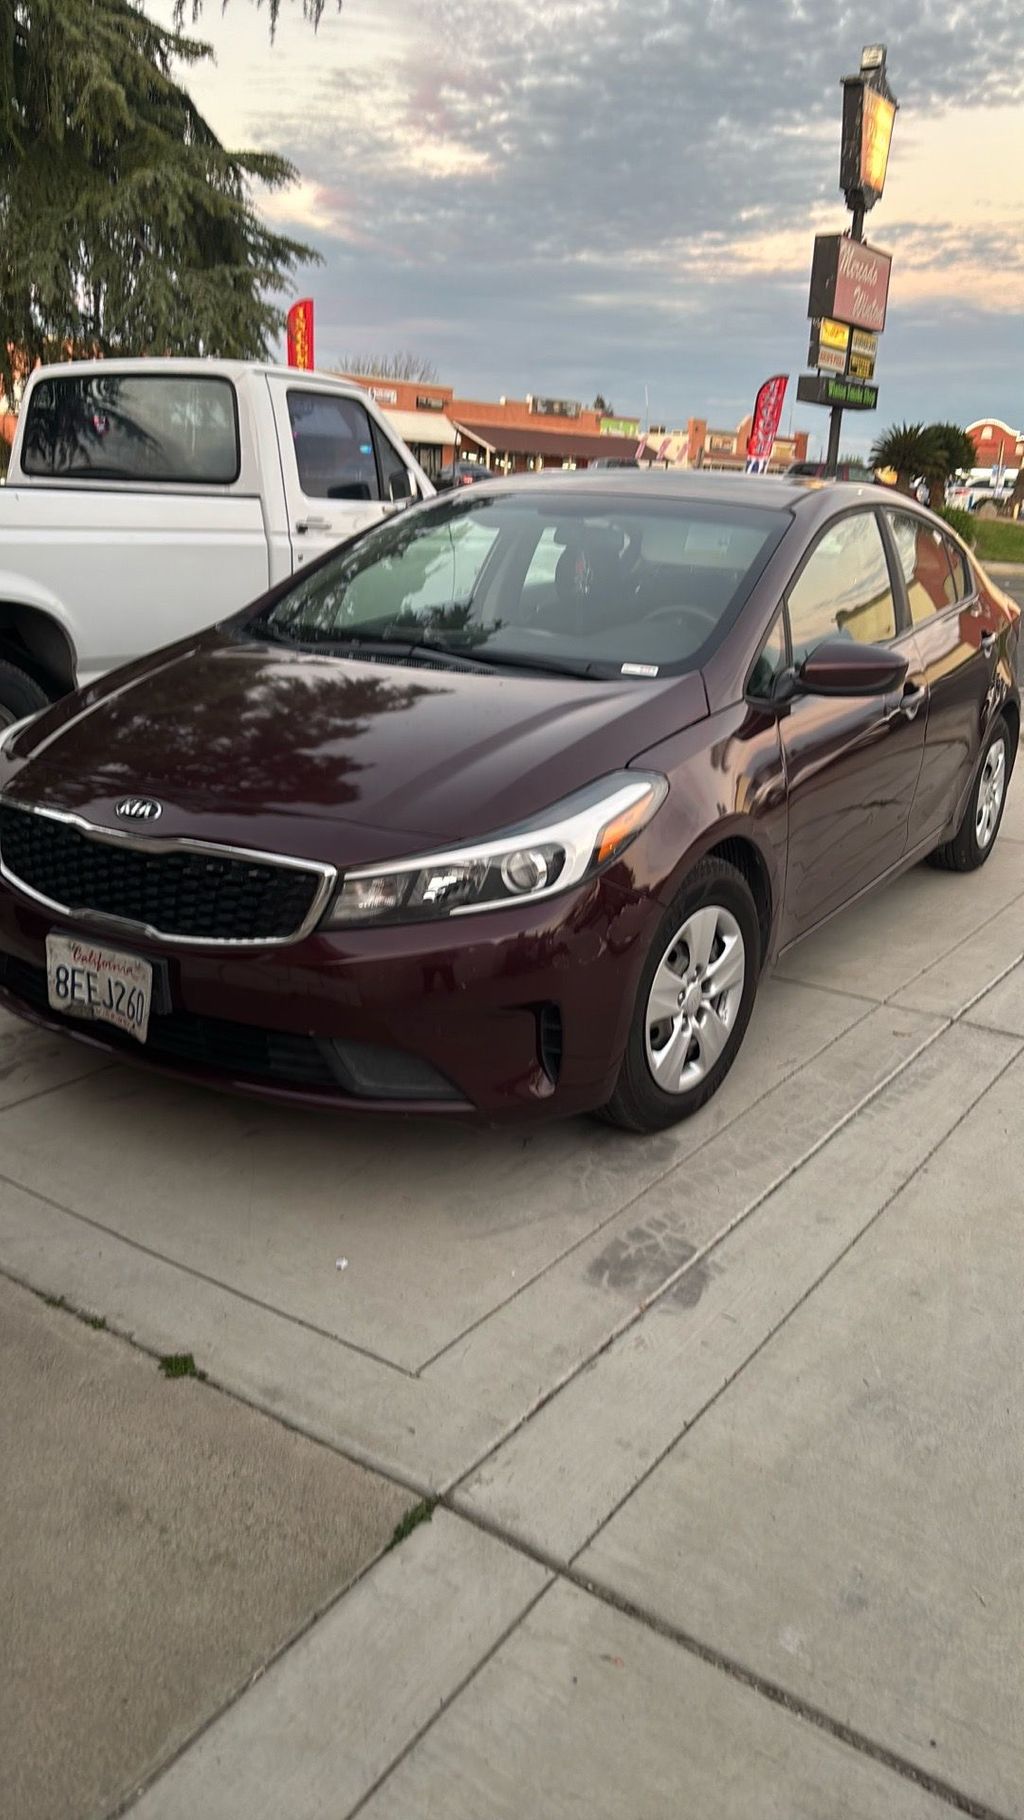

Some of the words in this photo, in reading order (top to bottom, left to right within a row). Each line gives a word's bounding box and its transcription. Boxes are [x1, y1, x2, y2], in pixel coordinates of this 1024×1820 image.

[118, 799, 154, 819] KIA
[72, 943, 138, 978] California
[56, 964, 144, 1026] 8EEJ260
